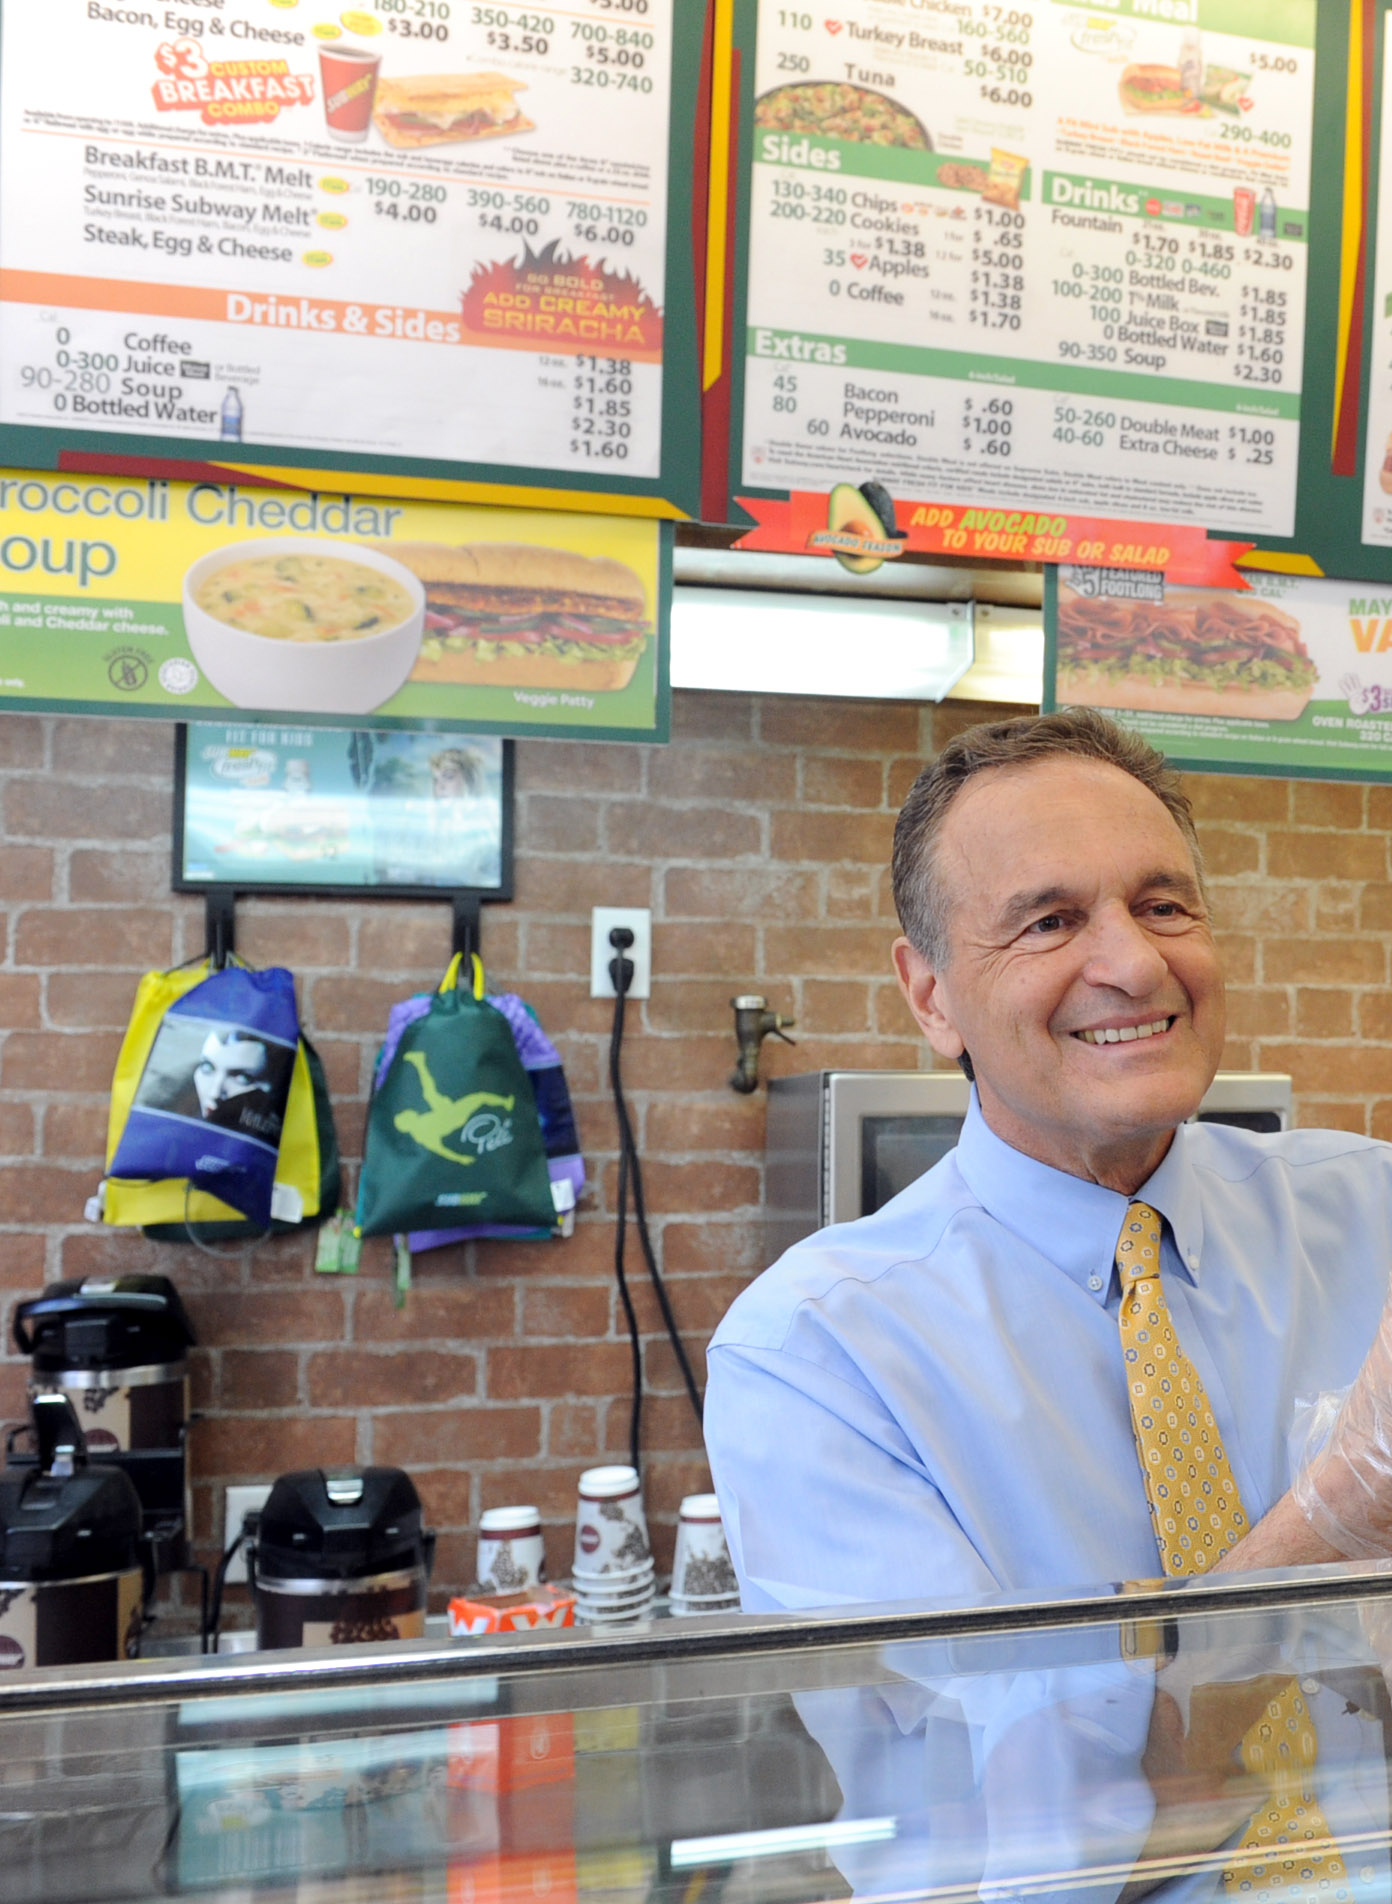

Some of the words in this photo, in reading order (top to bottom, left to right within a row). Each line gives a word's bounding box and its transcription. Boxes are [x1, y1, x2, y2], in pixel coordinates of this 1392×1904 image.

[87, 1, 158, 29] Bacon,
[165, 12, 204, 38] Egg
[230, 20, 305, 46] Cheese
[389, 18, 449, 41] $3.00
[471, 7, 555, 34] 350-420
[779, 10, 812, 30] 110
[847, 21, 905, 47] Turkey
[909, 31, 963, 55] Breast
[487, 31, 549, 54] $3.50
[570, 22, 653, 49] 700-840
[210, 59, 289, 77] CUSTOM
[586, 45, 644, 68] $5.00
[982, 45, 1033, 67] $6.00
[1251, 53, 1297, 73] $5.00
[570, 67, 653, 93] 320-740
[777, 53, 809, 73] 250
[844, 63, 895, 87] Tuna
[158, 75, 315, 103] BREAKFAST
[980, 85, 1033, 107] $6.00
[207, 101, 280, 118] COMBO
[1220, 123, 1292, 148] 290-400
[762, 135, 841, 170] Sides
[85, 145, 189, 175] Breakfast
[265, 165, 313, 189] Melt
[366, 177, 447, 204] 190-280
[467, 190, 550, 215] 390-560
[1052, 176, 1139, 213] Drinks
[84, 184, 166, 211] Sunrise
[171, 193, 257, 223] Subway
[375, 202, 437, 223] $4.00
[566, 202, 647, 226] 780-1120
[772, 179, 847, 206] 130-340
[851, 192, 897, 216] Chips
[974, 208, 1025, 230] $1.00
[479, 214, 538, 235] $4.00
[770, 200, 845, 226] 200-220
[850, 212, 919, 236] Cookies
[1052, 209, 1123, 234] Fountain
[84, 224, 148, 250] Steak,
[153, 231, 191, 256] Egg
[218, 238, 293, 262] Cheese
[574, 224, 634, 245] $6.00
[875, 238, 925, 259] $1.38
[973, 249, 1023, 270] $5.00
[1133, 232, 1179, 254] $1.70
[1188, 241, 1234, 262] $1.85
[1244, 248, 1293, 270] $2.30
[824, 249, 845, 267] 35
[868, 255, 929, 279] Apples
[554, 275, 604, 291] BOLD
[972, 271, 1024, 291] $1.38
[1052, 280, 1122, 303] 100-200
[1129, 270, 1186, 293] Bottled
[483, 292, 531, 308] ADD
[540, 296, 646, 321] CREAMY
[847, 283, 904, 306] Coffee
[970, 289, 1021, 310] $1.38
[226, 294, 335, 330] Drinks
[375, 309, 460, 342] Sides
[483, 308, 645, 343] SRIRACHA
[969, 310, 1021, 330] $1.70
[1126, 312, 1166, 332] Juice
[1169, 314, 1200, 334] Box
[124, 332, 191, 355] Coffee
[755, 330, 847, 364] Extras
[1117, 326, 1177, 351] Bottled
[1180, 335, 1230, 357] Water
[57, 351, 118, 372] 0-300
[123, 356, 174, 376] Juice
[576, 354, 631, 376] $1.38
[1124, 348, 1167, 370] Soup
[20, 366, 111, 395] 90-280
[122, 378, 183, 403] Soup
[574, 376, 632, 394] $1.60
[774, 375, 797, 393] 45
[844, 383, 898, 404] Bacon
[72, 395, 149, 419] Bottled
[154, 403, 217, 424] Water
[574, 397, 630, 417] $1.85
[773, 395, 796, 413] 80
[843, 402, 935, 427] Pepperoni
[963, 416, 1012, 436] $1.00
[572, 418, 631, 438] $2.30
[807, 419, 829, 435] 60
[840, 423, 917, 447] Avocado
[1054, 406, 1116, 429] 50-260
[1120, 416, 1178, 437] Double
[1180, 424, 1220, 443] Meat
[1228, 426, 1274, 446] $1.00
[570, 439, 628, 459] $1.60
[1053, 426, 1104, 447] 40-60
[1119, 435, 1159, 454] Extra
[1163, 438, 1218, 461] Cheese
[186, 484, 402, 537] Cheddar
[911, 507, 953, 527] ADD
[960, 509, 1067, 537] AVOCADO
[942, 530, 965, 548] TO
[975, 532, 1027, 553] YOUR
[1031, 537, 1071, 556] SUB
[1076, 540, 1106, 559] OR
[1109, 544, 1171, 565] SALAD
[1101, 580, 1162, 600] FOOTLONG
[12, 602, 41, 614] and
[44, 604, 98, 621] creamy
[102, 606, 134, 620] with
[1349, 599, 1392, 616] MAY
[14, 616, 43, 628] and
[46, 617, 109, 632] Cheddar
[112, 622, 169, 636] cheese.
[513, 691, 559, 708] Veggie
[560, 695, 595, 709] Patty
[1312, 716, 1343, 729] OVEN
